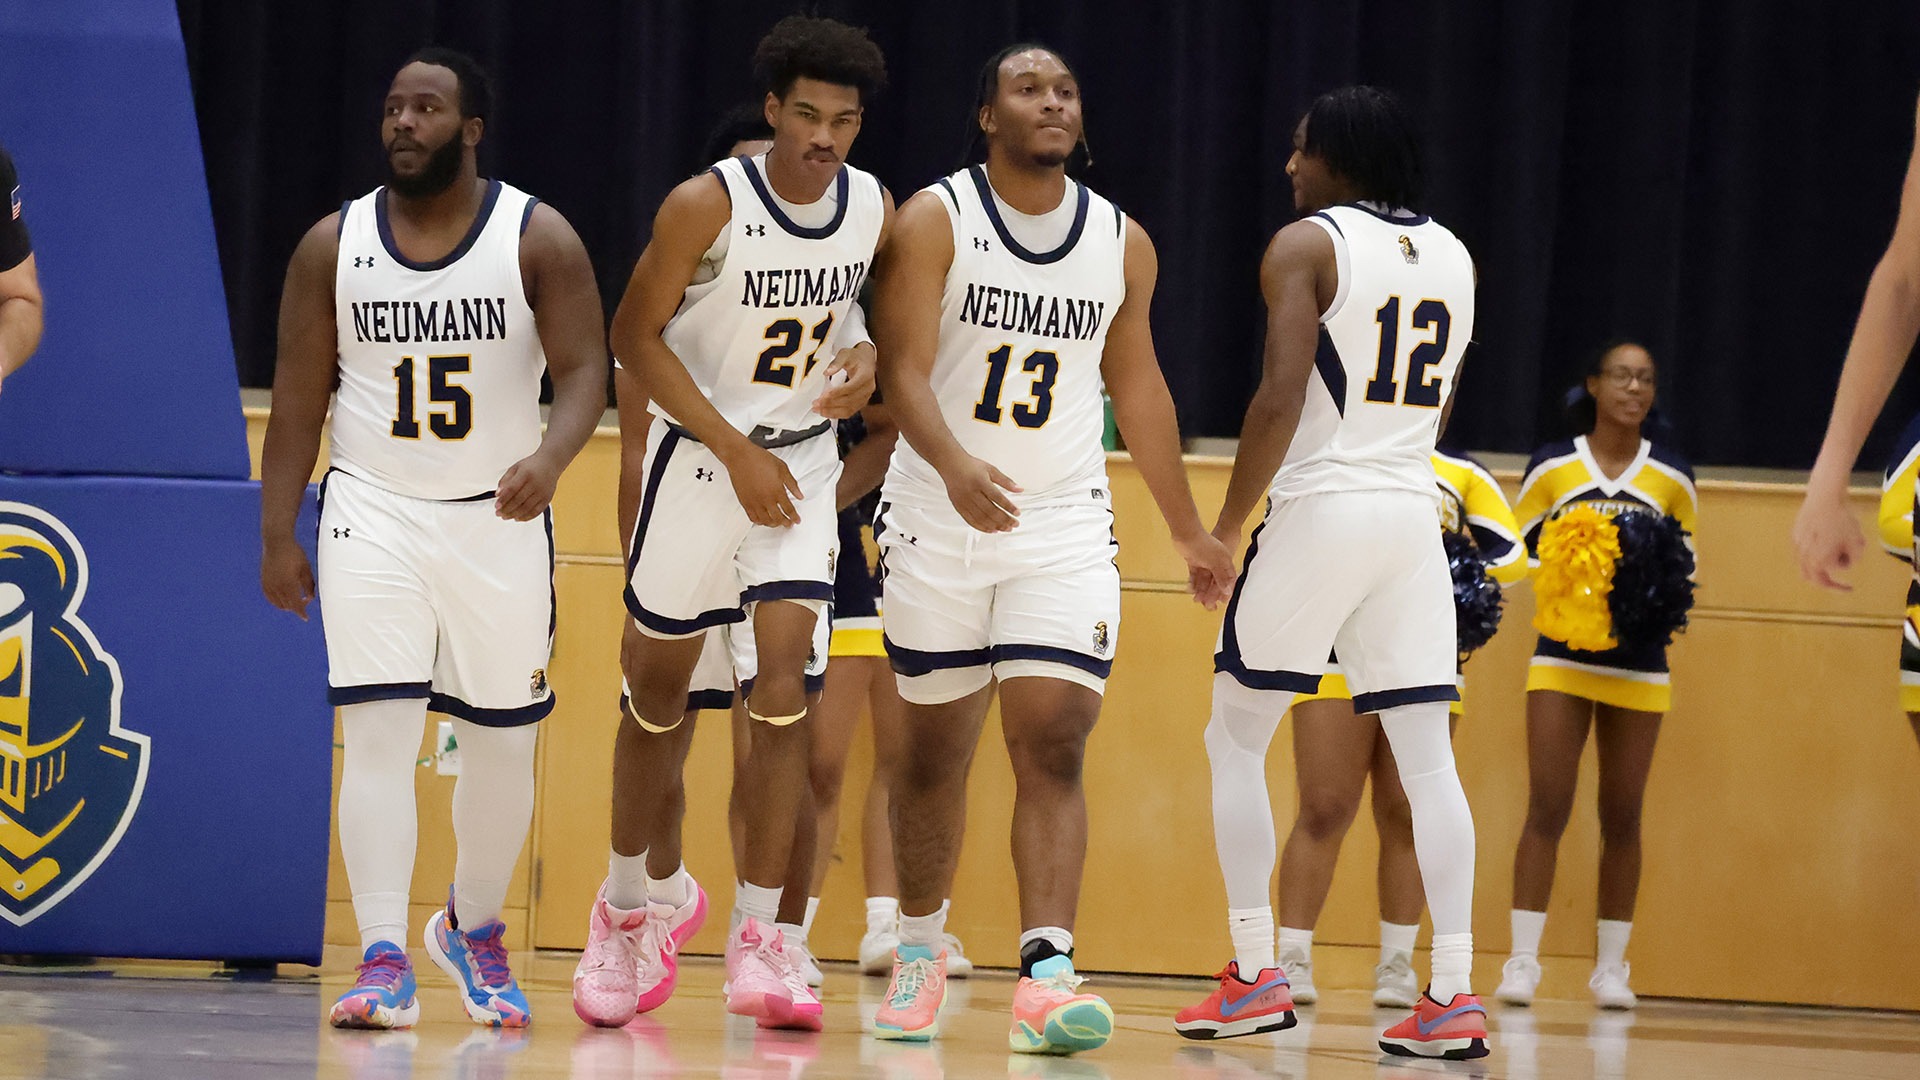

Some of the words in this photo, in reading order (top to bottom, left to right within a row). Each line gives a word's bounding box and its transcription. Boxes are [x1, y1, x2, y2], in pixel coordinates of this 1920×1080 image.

[351, 297, 506, 343] NEUMANN
[960, 283, 1104, 340] NEUMANN
[1364, 294, 1452, 409] 12
[390, 353, 473, 441] 15
[972, 342, 1061, 430] 13
